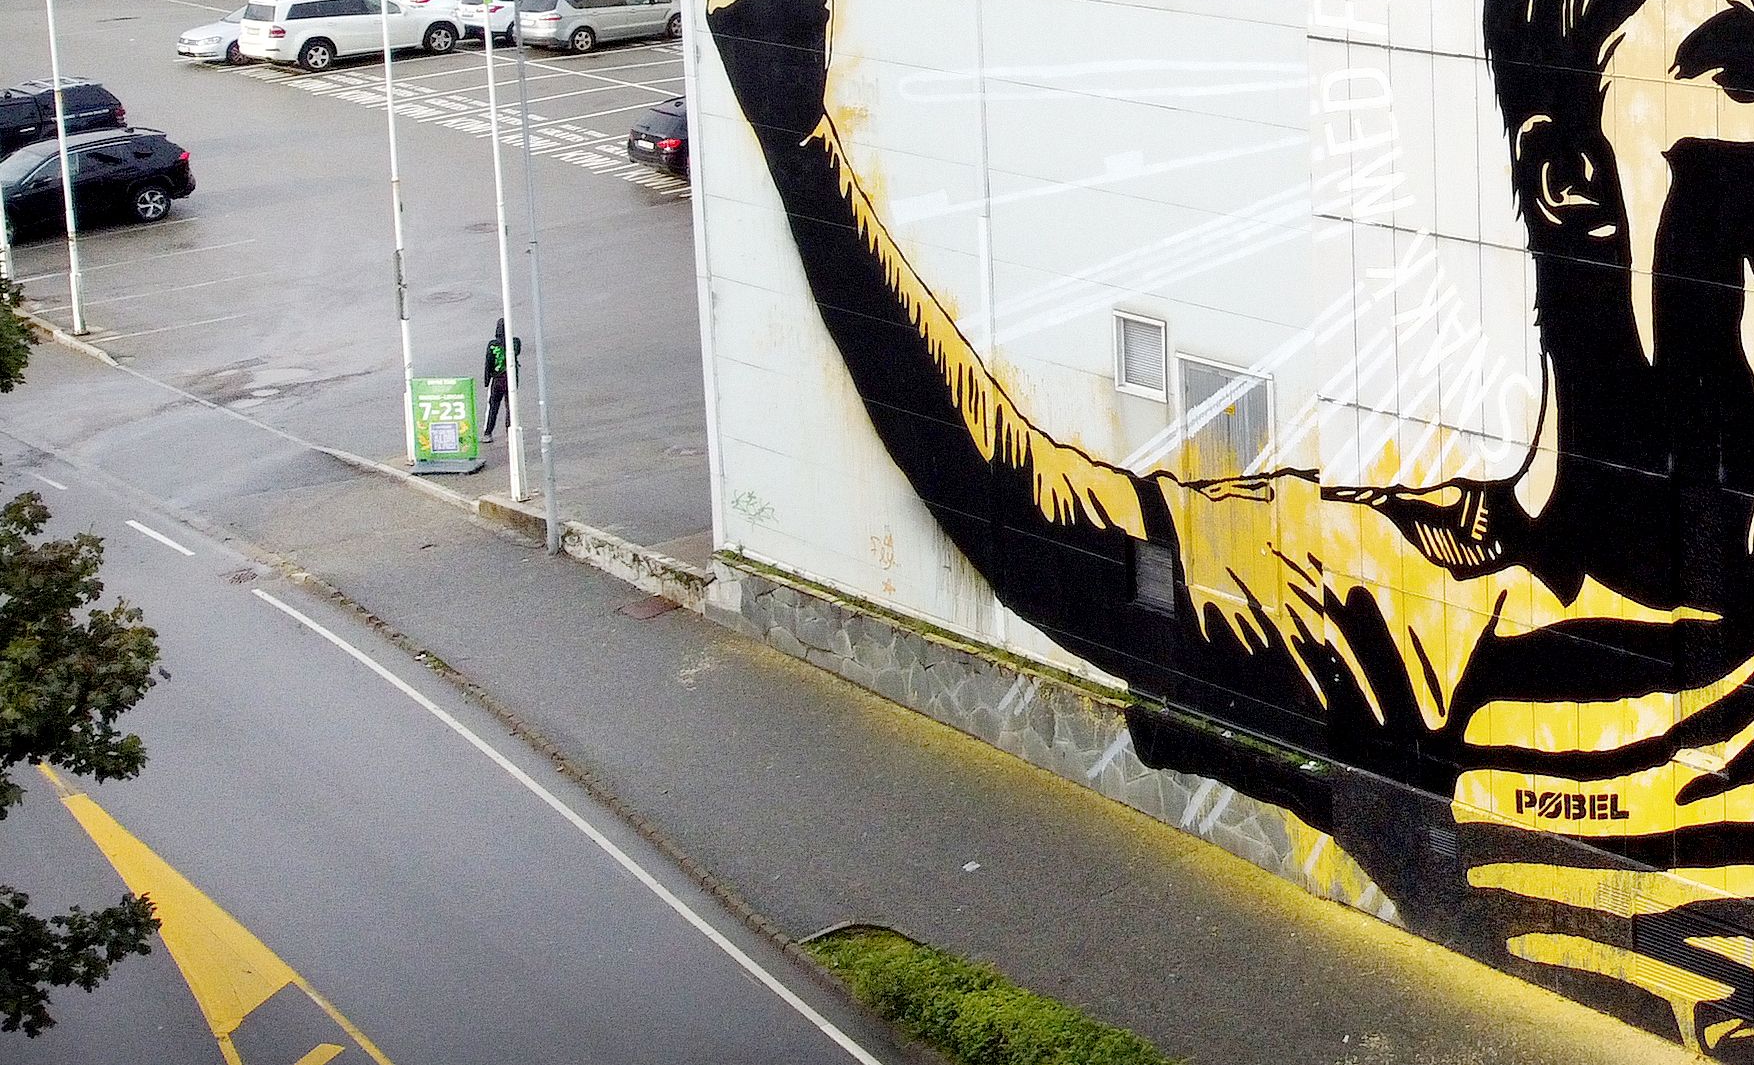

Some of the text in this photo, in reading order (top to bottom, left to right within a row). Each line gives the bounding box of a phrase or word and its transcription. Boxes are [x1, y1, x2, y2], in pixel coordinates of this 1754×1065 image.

[1320, 67, 1416, 219] MED
[1366, 225, 1538, 464] SNAKK
[418, 401, 466, 421] 7-23
[1514, 787, 1631, 821] PØBEL
